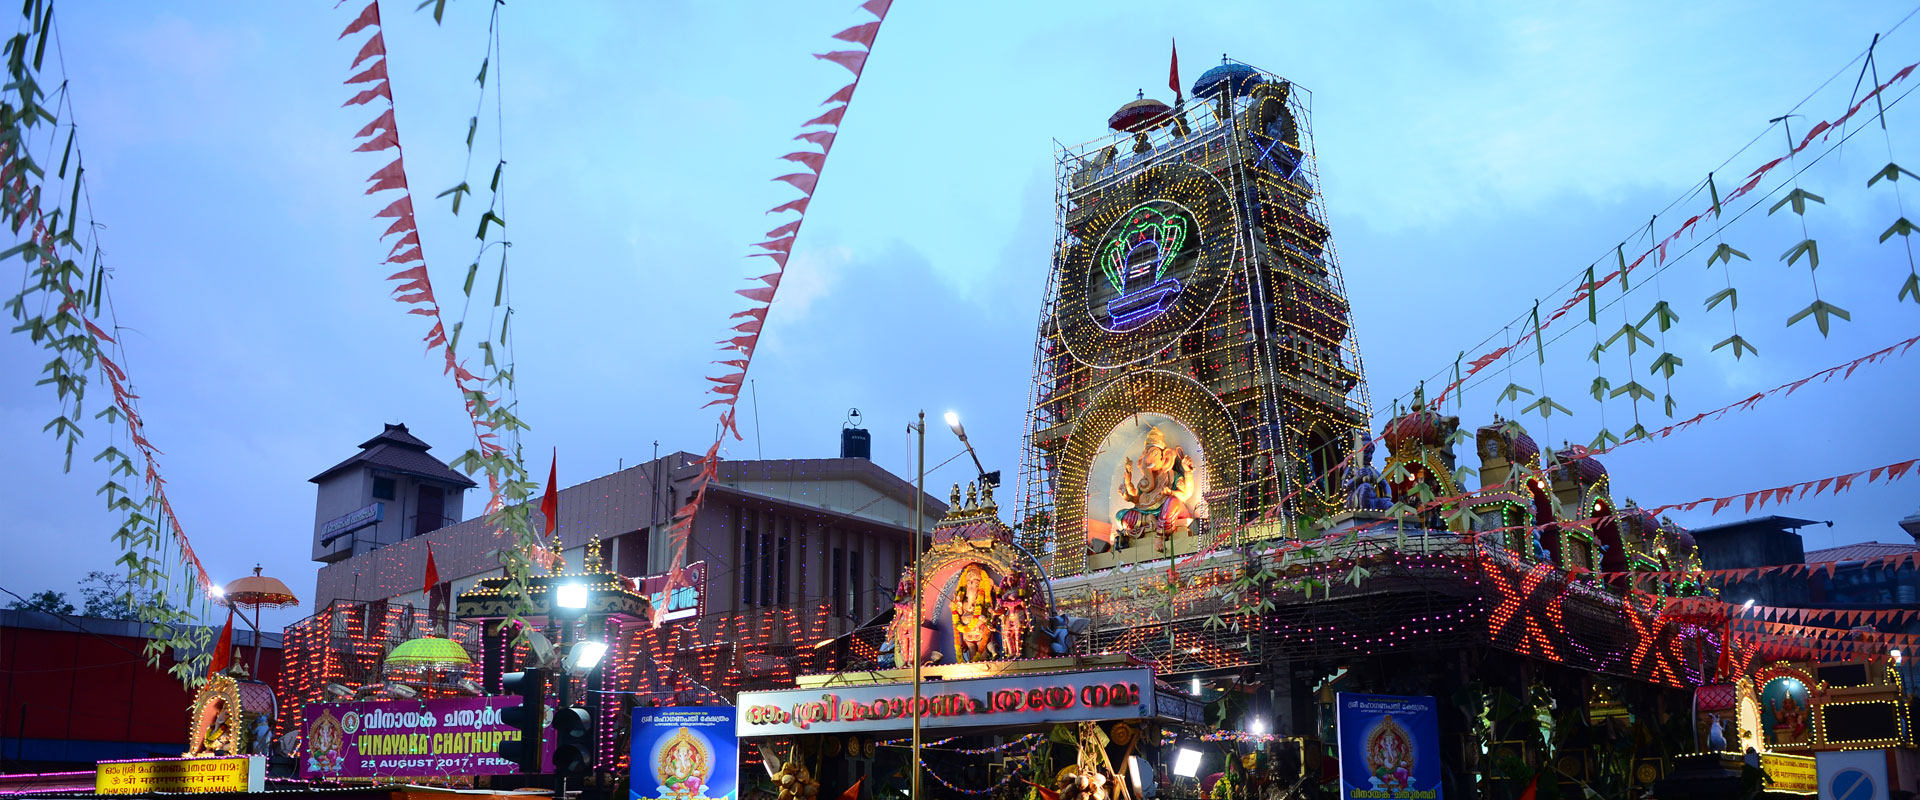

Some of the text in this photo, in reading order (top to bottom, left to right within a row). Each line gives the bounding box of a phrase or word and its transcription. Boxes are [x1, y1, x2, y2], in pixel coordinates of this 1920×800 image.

[364, 708, 437, 729] വിനായക
[358, 734, 428, 755] VINAYAKA
[361, 760, 376, 768] 25
[380, 759, 433, 768] AUGUST
[438, 758, 473, 768] 2017,
